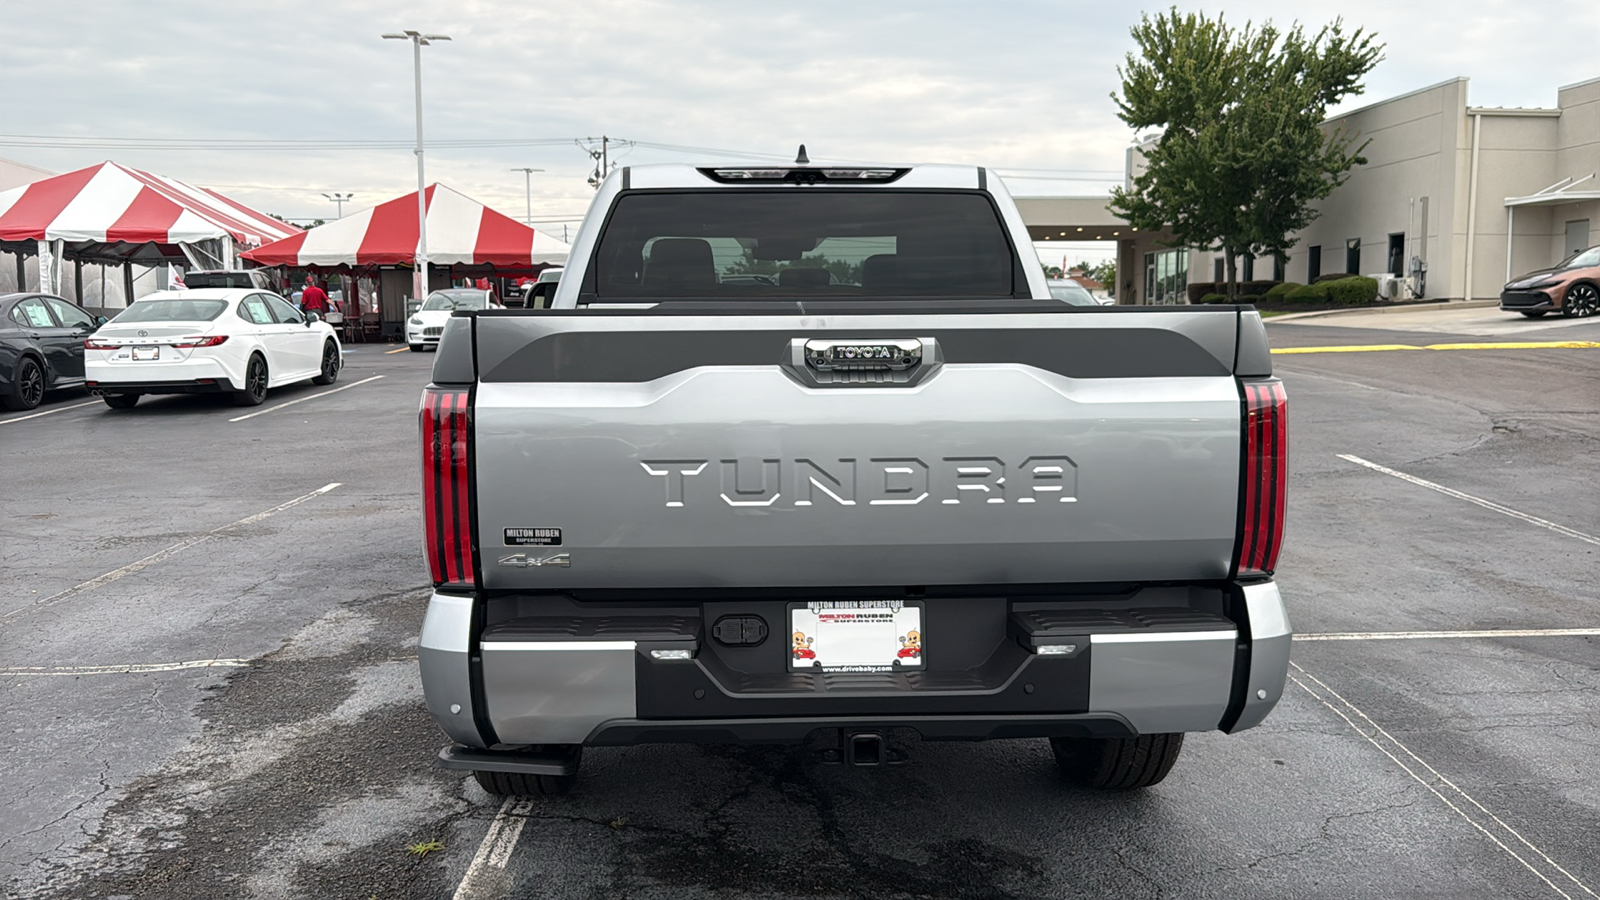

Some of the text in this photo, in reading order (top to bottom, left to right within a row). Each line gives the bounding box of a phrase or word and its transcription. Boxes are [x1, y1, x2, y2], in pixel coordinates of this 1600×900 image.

[836, 346, 891, 358] TOYOTA
[639, 455, 1079, 507] TUNDRA
[506, 529, 560, 537] MILTON RUBEN
[807, 600, 904, 609] MILTON RUBEN SUPERSTORE
[822, 665, 893, 673] www.drivebaby.com
